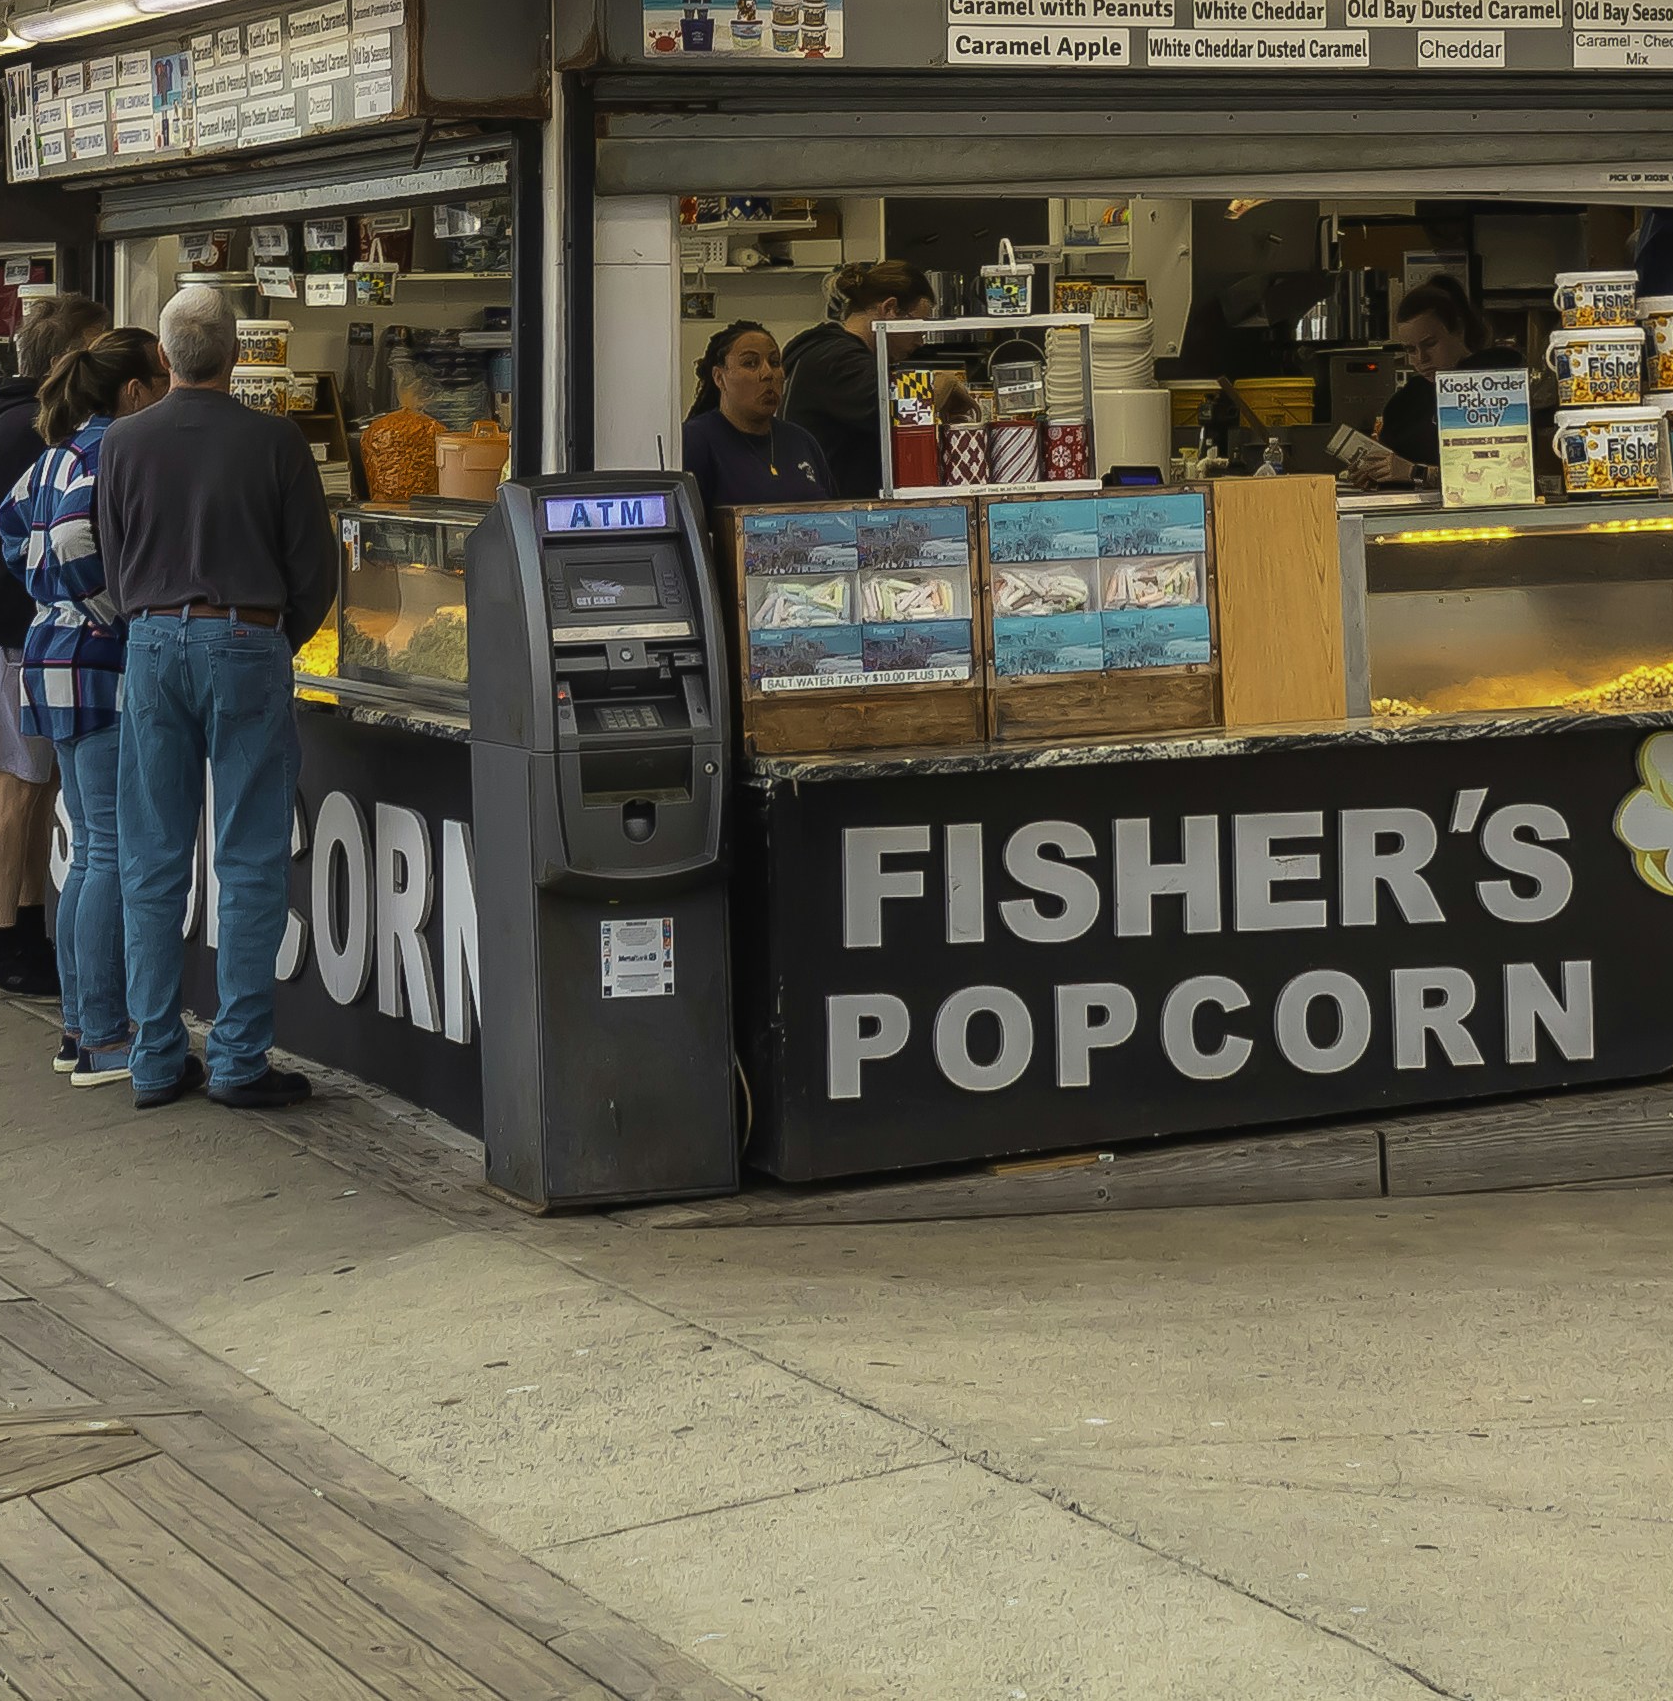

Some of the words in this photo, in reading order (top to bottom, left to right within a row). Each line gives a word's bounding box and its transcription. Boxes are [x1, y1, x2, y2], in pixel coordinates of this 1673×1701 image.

[1093, 0, 1173, 18] Peanuts
[1195, 0, 1247, 20] White
[1252, 1, 1324, 20] Cheddar
[1348, 0, 1377, 19] Old
[1384, 1, 1416, 23] Bay
[1422, 1, 1483, 20] Dusted
[1488, 0, 1561, 19] Caramel
[1574, 3, 1599, 21] Old
[1603, 3, 1629, 25] Bay
[956, 36, 1049, 56] Caramel
[1057, 36, 1121, 61] Apple
[1149, 39, 1190, 57] White
[1195, 39, 1256, 58] Cheddar
[1258, 39, 1305, 58] Dusted
[1310, 39, 1368, 58] Caramel
[1419, 40, 1502, 59] Cheddar
[1576, 34, 1630, 48] Caramel
[1626, 52, 1648, 65] Mix
[1439, 377, 1479, 393] Kiosk
[1482, 376, 1525, 391] Order
[1458, 393, 1486, 408] Pick
[1490, 397, 1509, 410] up
[1468, 409, 1500, 426] Only
[570, 501, 644, 527] ATM
[768, 678, 793, 689] SALT
[797, 676, 834, 687] WATER
[837, 674, 869, 685] TAFFY
[873, 672, 904, 682] $10.00
[908, 670, 934, 680] PLUS
[938, 669, 957, 678] TAX
[842, 788, 1573, 949] FISHER'S
[827, 959, 1595, 1100] POPCORN
